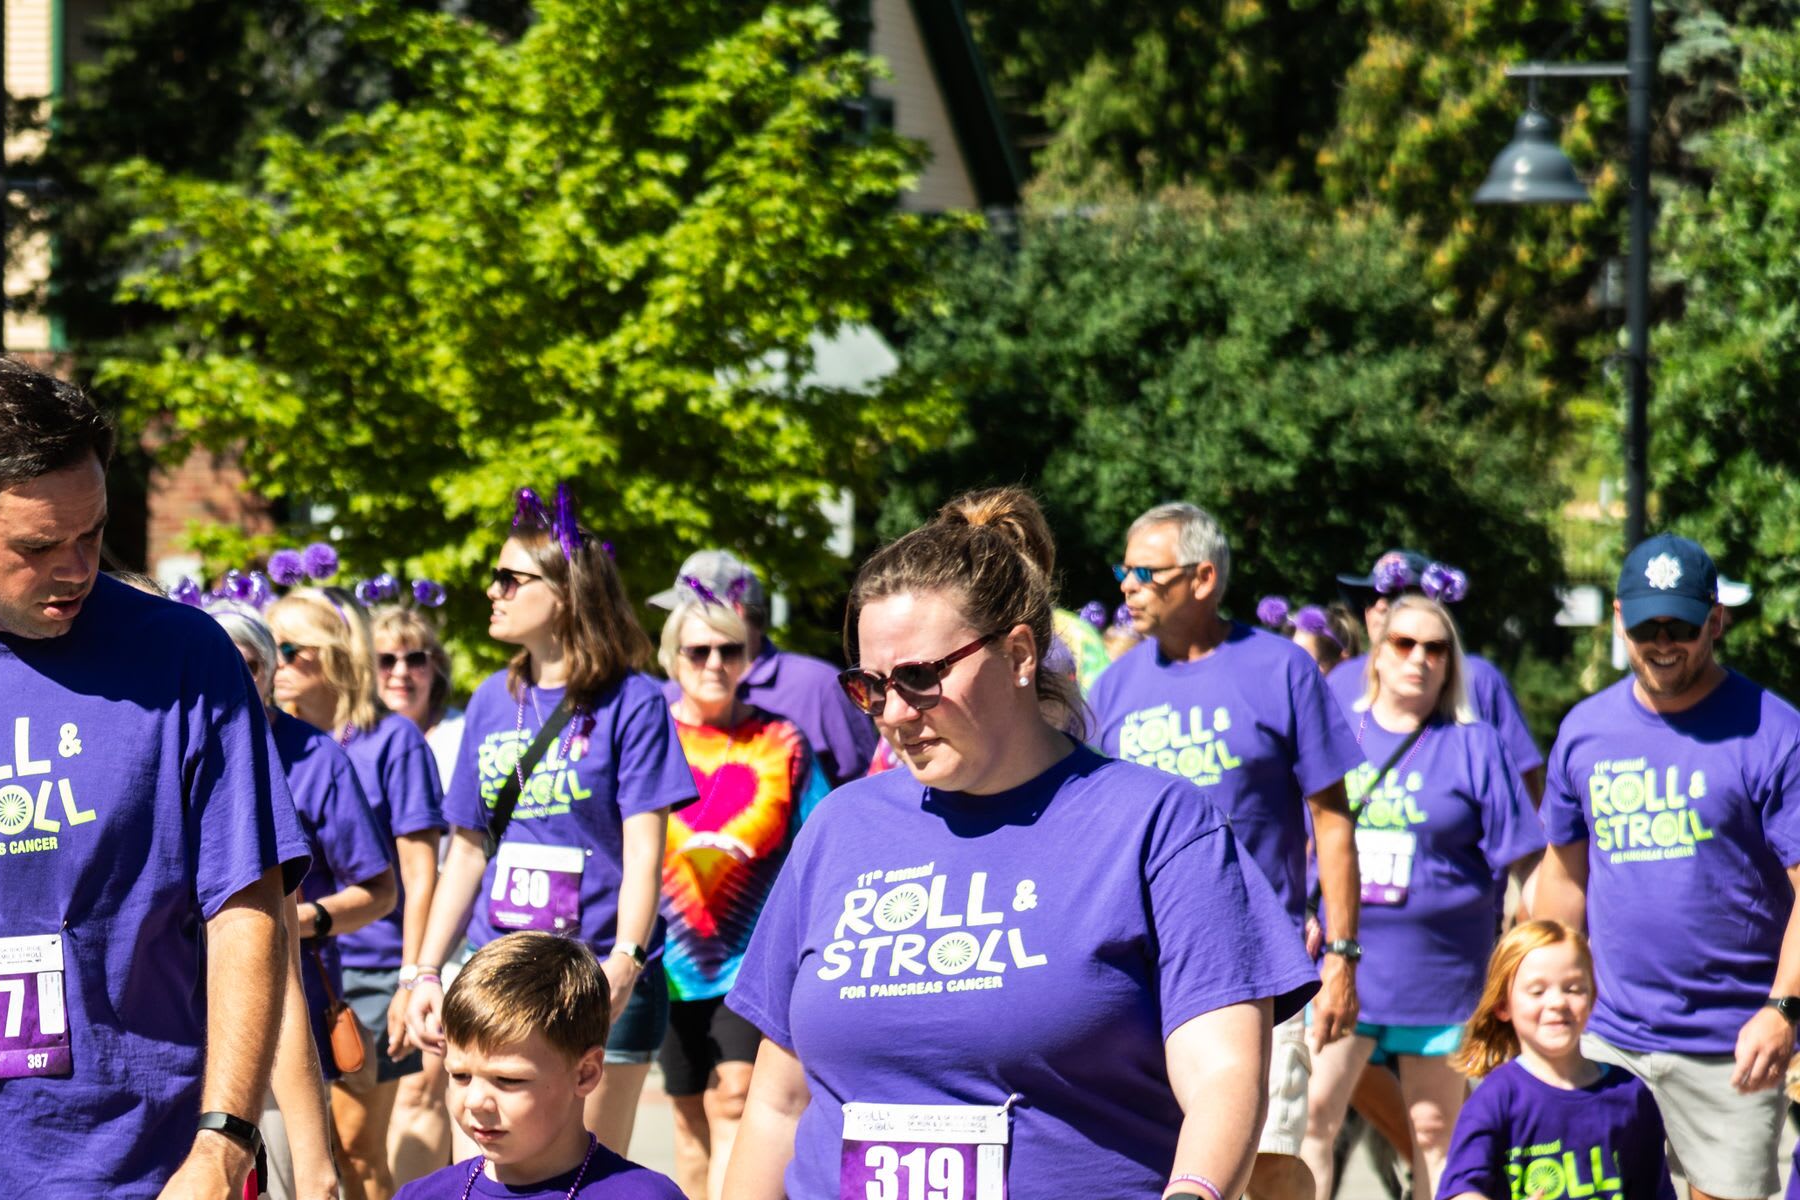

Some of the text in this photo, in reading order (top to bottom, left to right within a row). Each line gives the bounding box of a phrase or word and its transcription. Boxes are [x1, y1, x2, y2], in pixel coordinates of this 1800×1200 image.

[58, 722, 83, 758] &
[1120, 706, 1214, 760] ROLL
[1589, 765, 1707, 818] ROLL &
[9, 836, 59, 855] CANCER
[1594, 808, 1714, 851] STROLL
[510, 868, 550, 909] 30
[884, 861, 935, 883] annual
[834, 872, 1038, 940] ROLL &
[817, 928, 1048, 981] STROLL
[840, 975, 1004, 1000] FOR PANCREAS CANCER
[27, 1053, 48, 1069] 387
